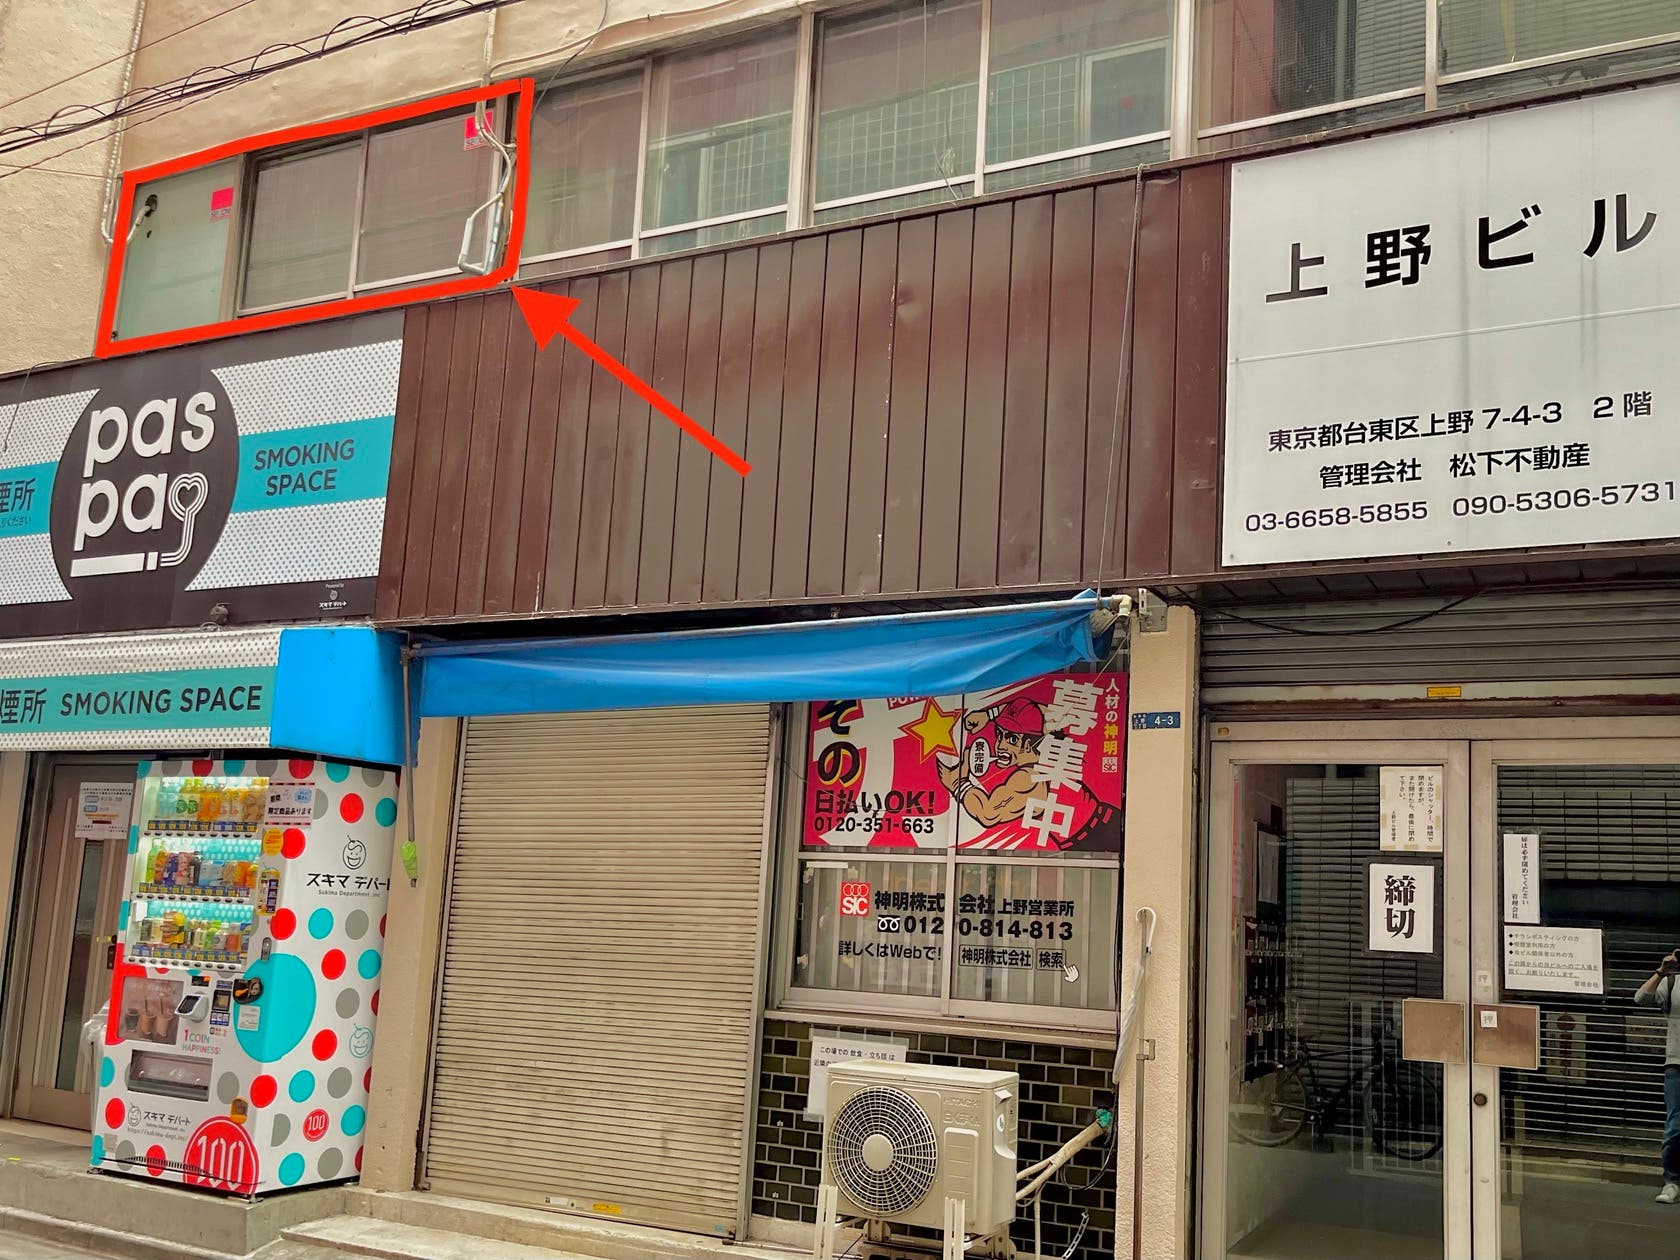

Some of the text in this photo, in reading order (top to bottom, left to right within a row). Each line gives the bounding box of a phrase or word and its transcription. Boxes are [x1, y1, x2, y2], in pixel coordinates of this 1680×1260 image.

[1265, 193, 1657, 303] 上野ビル
[83, 391, 217, 478] pas
[254, 438, 355, 471] SMOKING
[1319, 443, 1590, 489] 管理会社 松下不動産
[265, 467, 337, 497] SPACE
[1245, 480, 1676, 532] 03-6658-5855 090-5306-5731
[60, 688, 171, 717] SMOKING
[180, 685, 262, 713] SPACE
[1102, 677, 1120, 756] 人材の神明
[1154, 715, 1174, 726] 4-3
[1022, 678, 1104, 848] 募集中
[814, 789, 936, 815] 日払いOK!
[814, 815, 935, 835] 0120-351-663
[307, 873, 350, 888] スキマ
[1383, 874, 1417, 939] 締切
[838, 940, 1063, 968] 詳しくはWebで! 神明株式会社 検索
[184, 1029, 210, 1044] 1 COIN
[820, 1046, 848, 1056] この場での
[144, 1111, 166, 1122] スキマ
[308, 1114, 326, 1131] 100
[197, 1135, 245, 1191] 100
